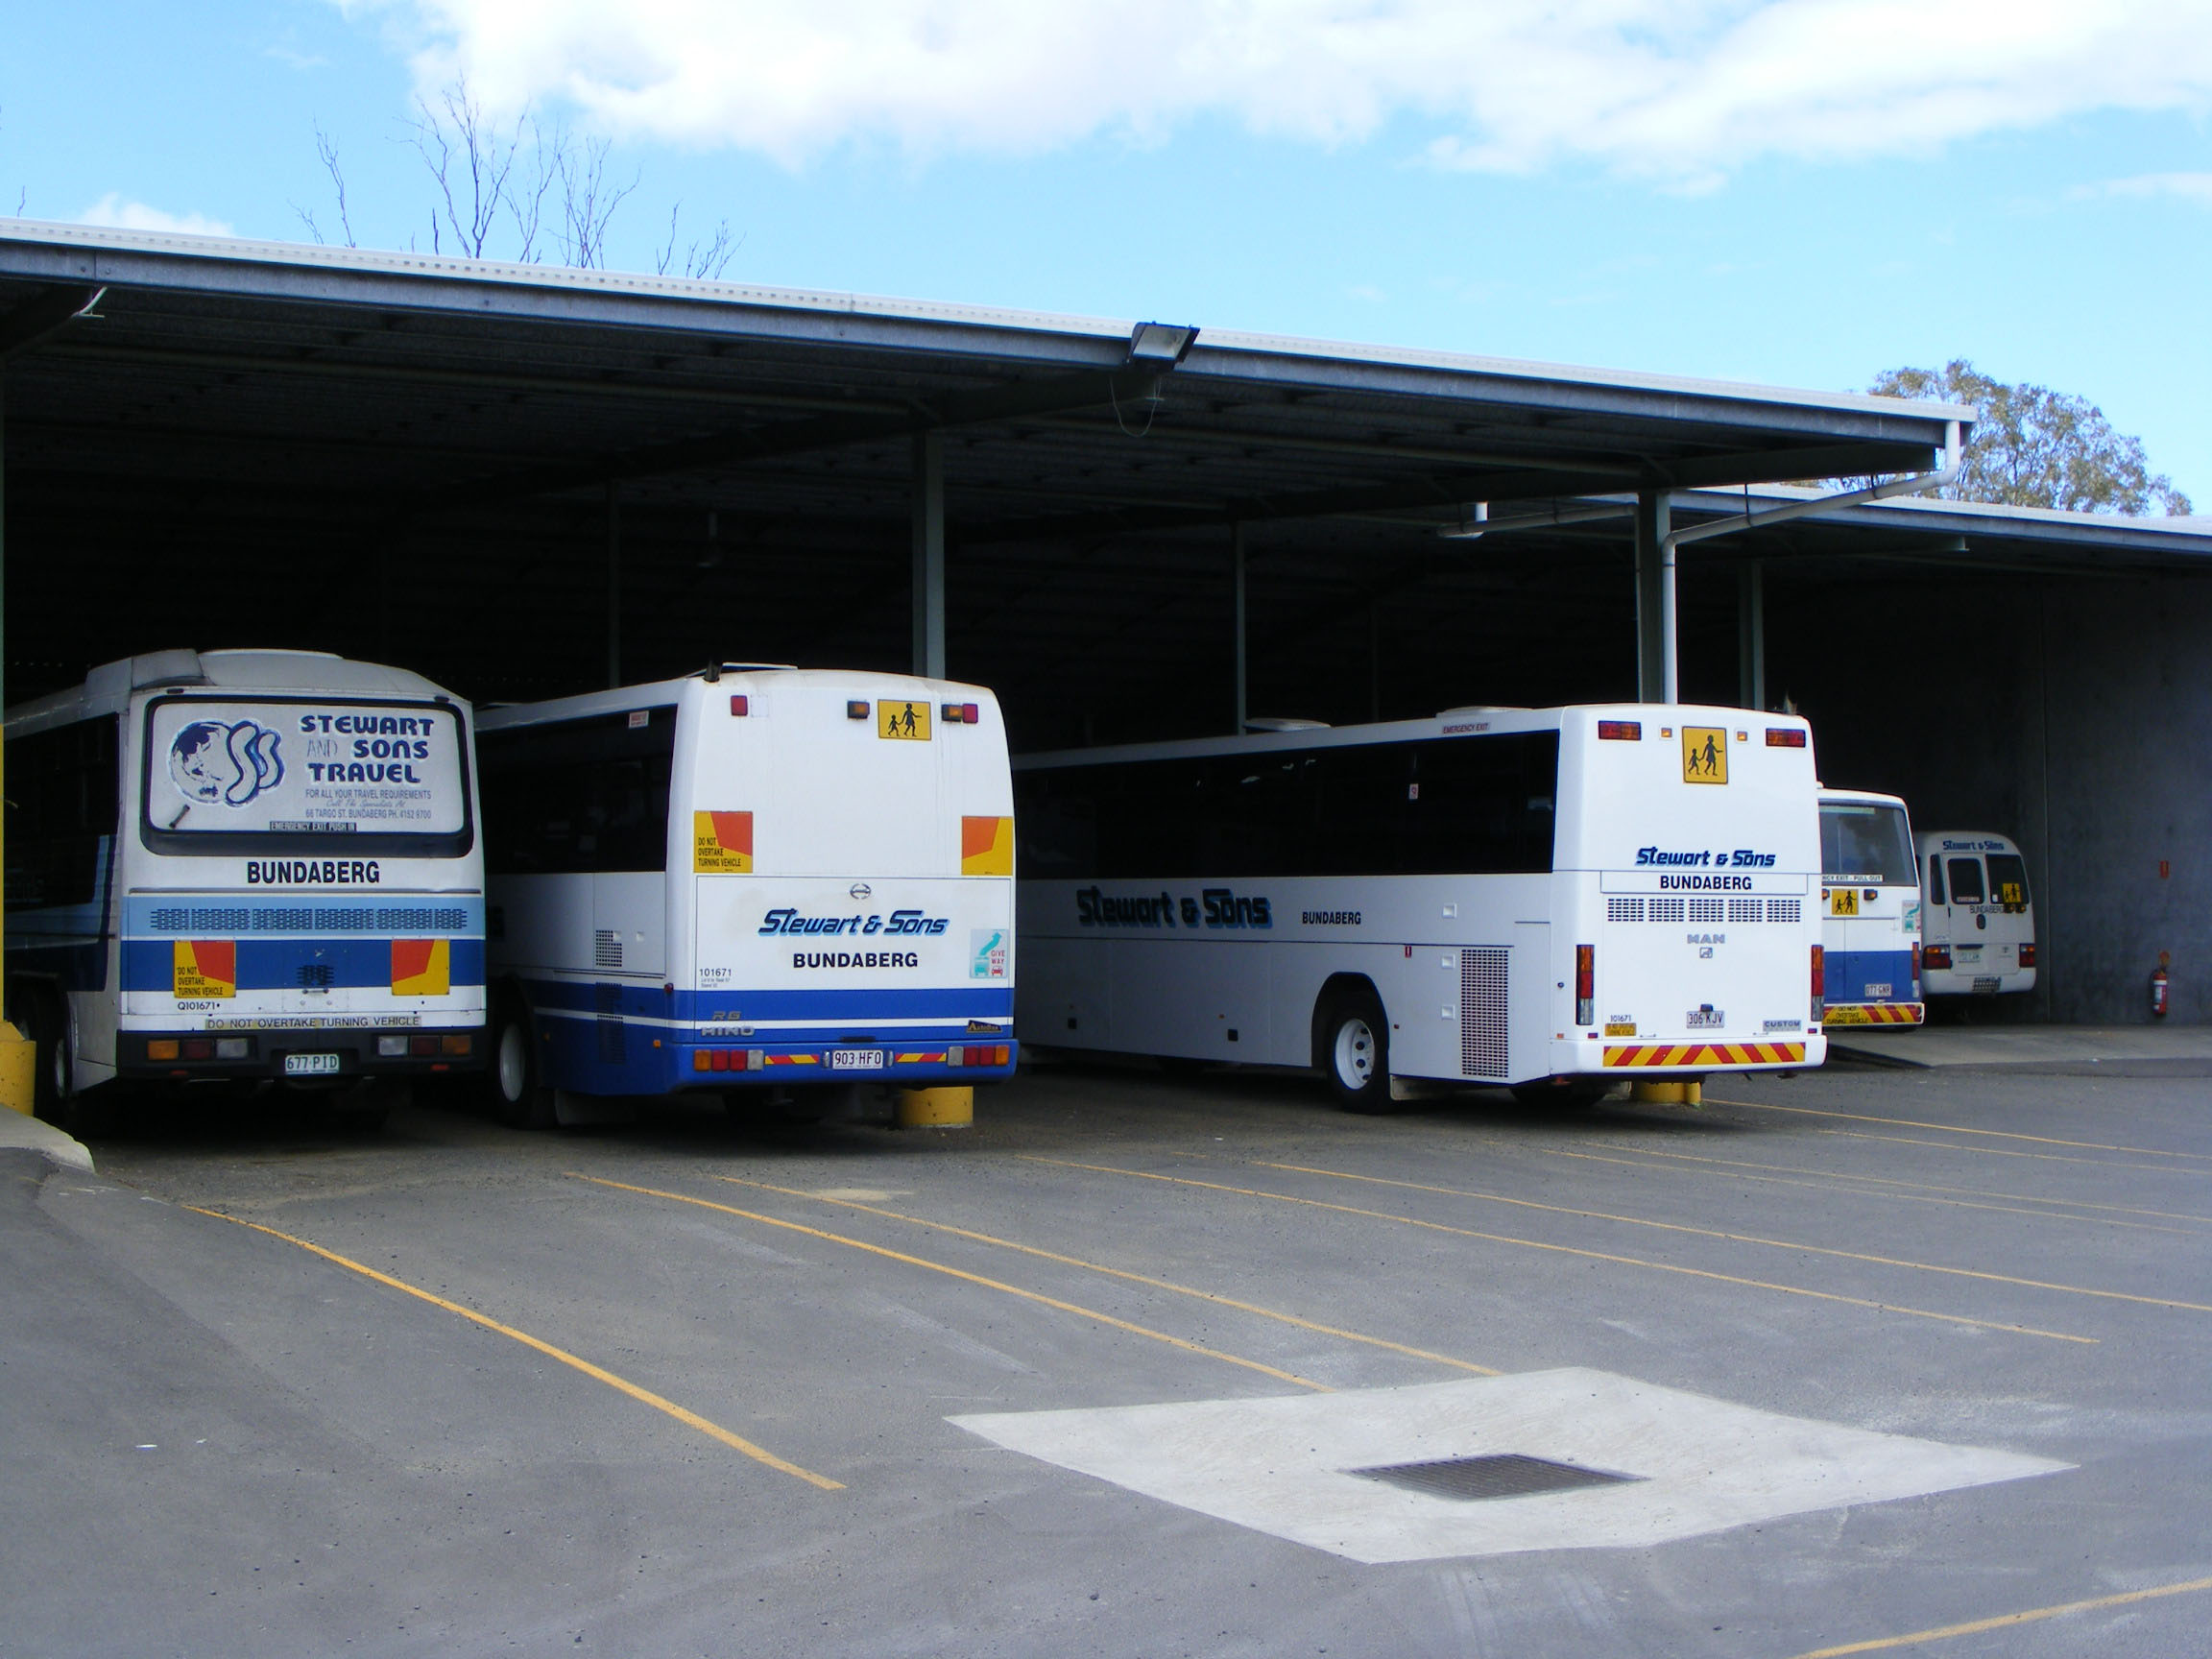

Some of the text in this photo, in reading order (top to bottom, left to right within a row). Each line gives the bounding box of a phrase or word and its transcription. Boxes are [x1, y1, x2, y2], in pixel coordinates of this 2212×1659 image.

[301, 715, 434, 736] STEWART
[1443, 722, 1488, 733] EMERGENCY EXIT
[307, 739, 428, 758] AND SONS
[308, 763, 421, 783] TRAVEL
[305, 789, 432, 800] FOR ALL YOUR TRAVEL REQUIREMENTS
[349, 809, 387, 819] BUNDABERG
[698, 836, 716, 846] DO NOT
[698, 847, 724, 856] OVERTAKE
[1635, 846, 1776, 869] Stewart & Sons
[698, 857, 741, 867] TURNING VEHICLE
[247, 861, 380, 883] BUNDABERG
[1659, 875, 1752, 890] BUNDABERG
[1076, 885, 1273, 929] Stewart & Sons
[757, 907, 950, 937] Stewart & Sons
[1302, 911, 1361, 926] BUNDABERG
[1687, 933, 1726, 945] MAN
[793, 952, 919, 968] BUNDABERG
[177, 966, 198, 975] DO NOT
[699, 968, 732, 977] 101671
[178, 976, 205, 985] OVERTAKE
[178, 986, 224, 996] TURNING VEHICLE
[178, 1001, 216, 1011] Q101671
[207, 1016, 420, 1029] DO NOT OVERTAKE TURNING VEHICLE
[1610, 1014, 1632, 1022] 101671
[700, 1026, 756, 1038] HINO
